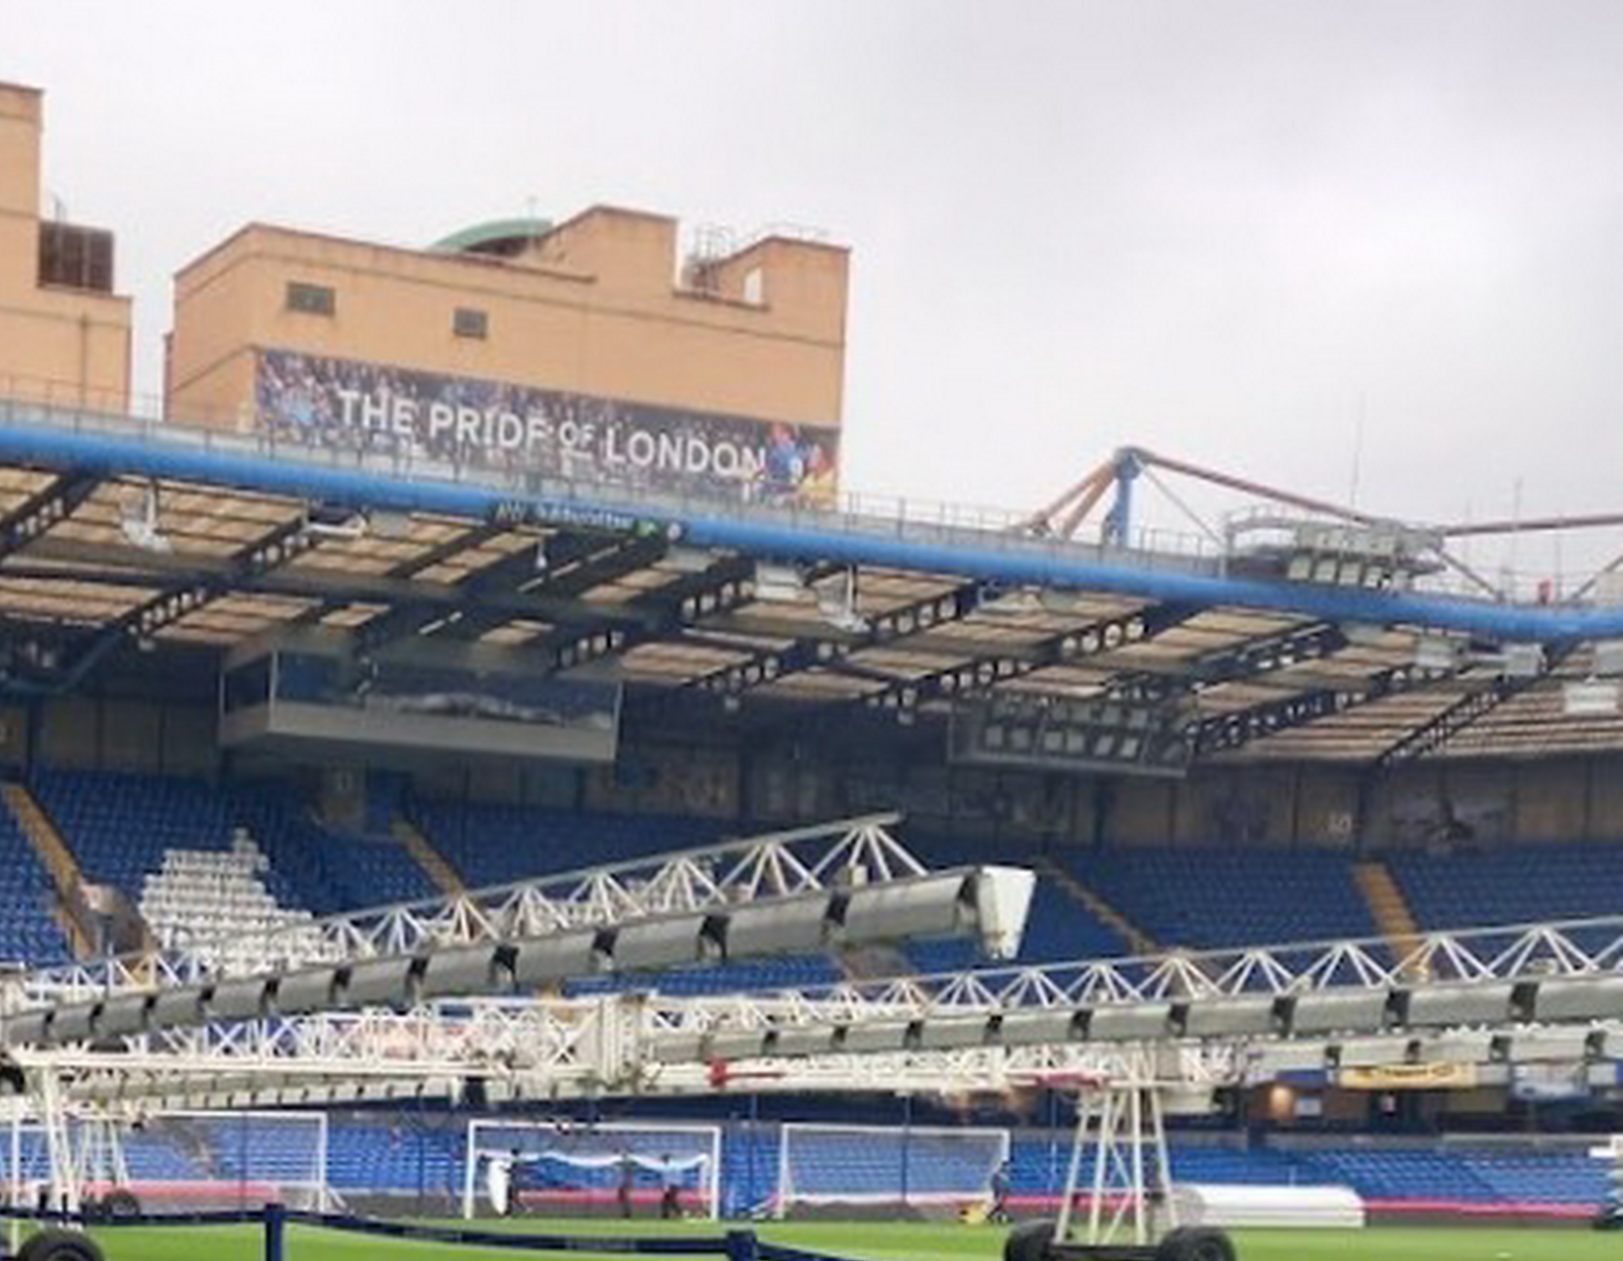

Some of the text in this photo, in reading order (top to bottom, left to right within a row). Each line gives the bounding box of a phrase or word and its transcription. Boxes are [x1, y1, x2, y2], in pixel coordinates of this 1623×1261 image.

[337, 389, 767, 478] THE PRIDE OF LONDON
